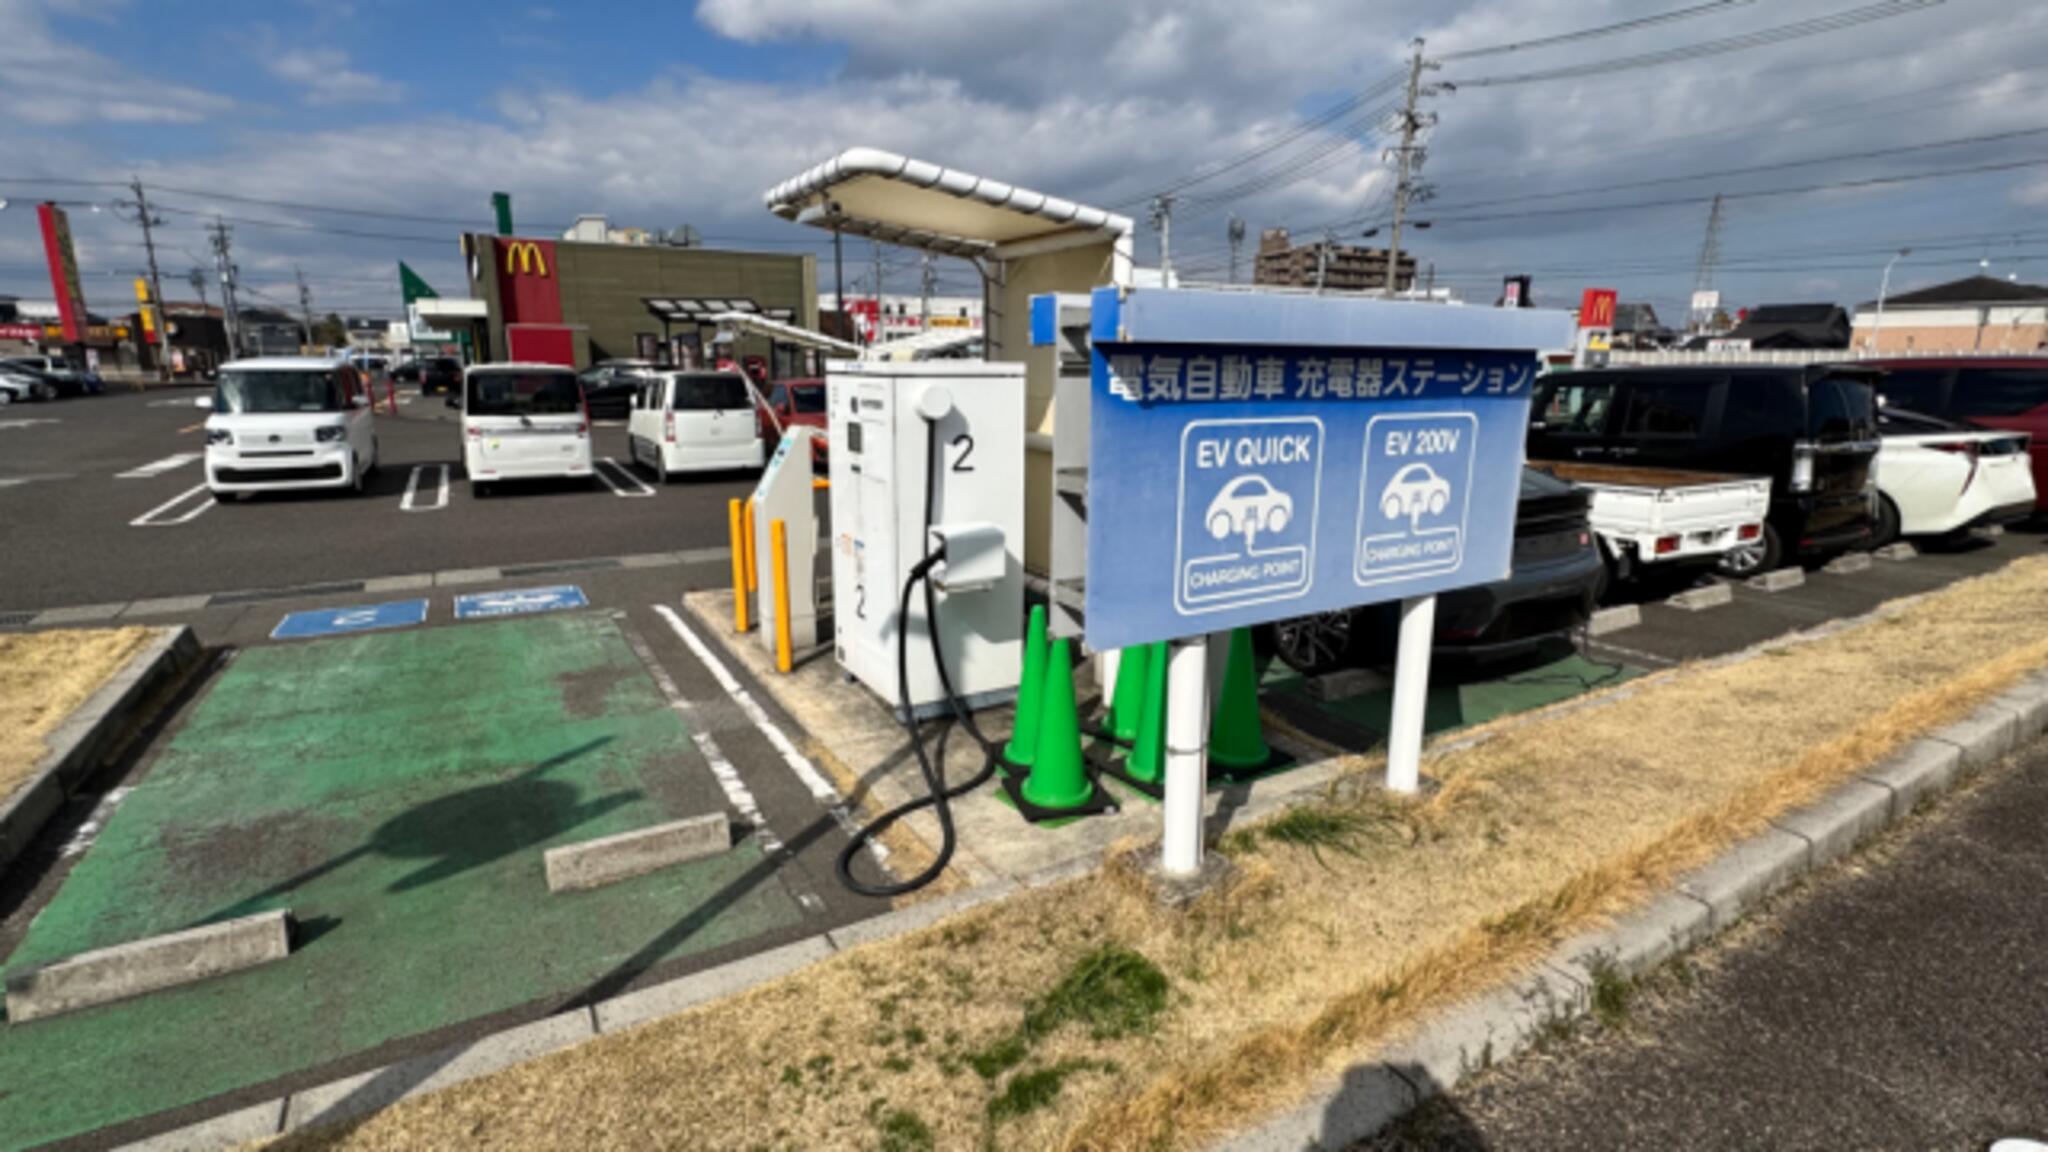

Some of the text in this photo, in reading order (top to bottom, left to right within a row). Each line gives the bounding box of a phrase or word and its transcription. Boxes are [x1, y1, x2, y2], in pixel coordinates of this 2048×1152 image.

[1107, 355, 1529, 401] 電気自動車 充電器ステーション
[951, 434, 975, 472] 2
[1197, 434, 1312, 469] EV QUICK
[1385, 428, 1461, 456] EV 200V
[1367, 537, 1454, 564] CHARGING POINT
[1190, 558, 1300, 589] CHARGING POINT
